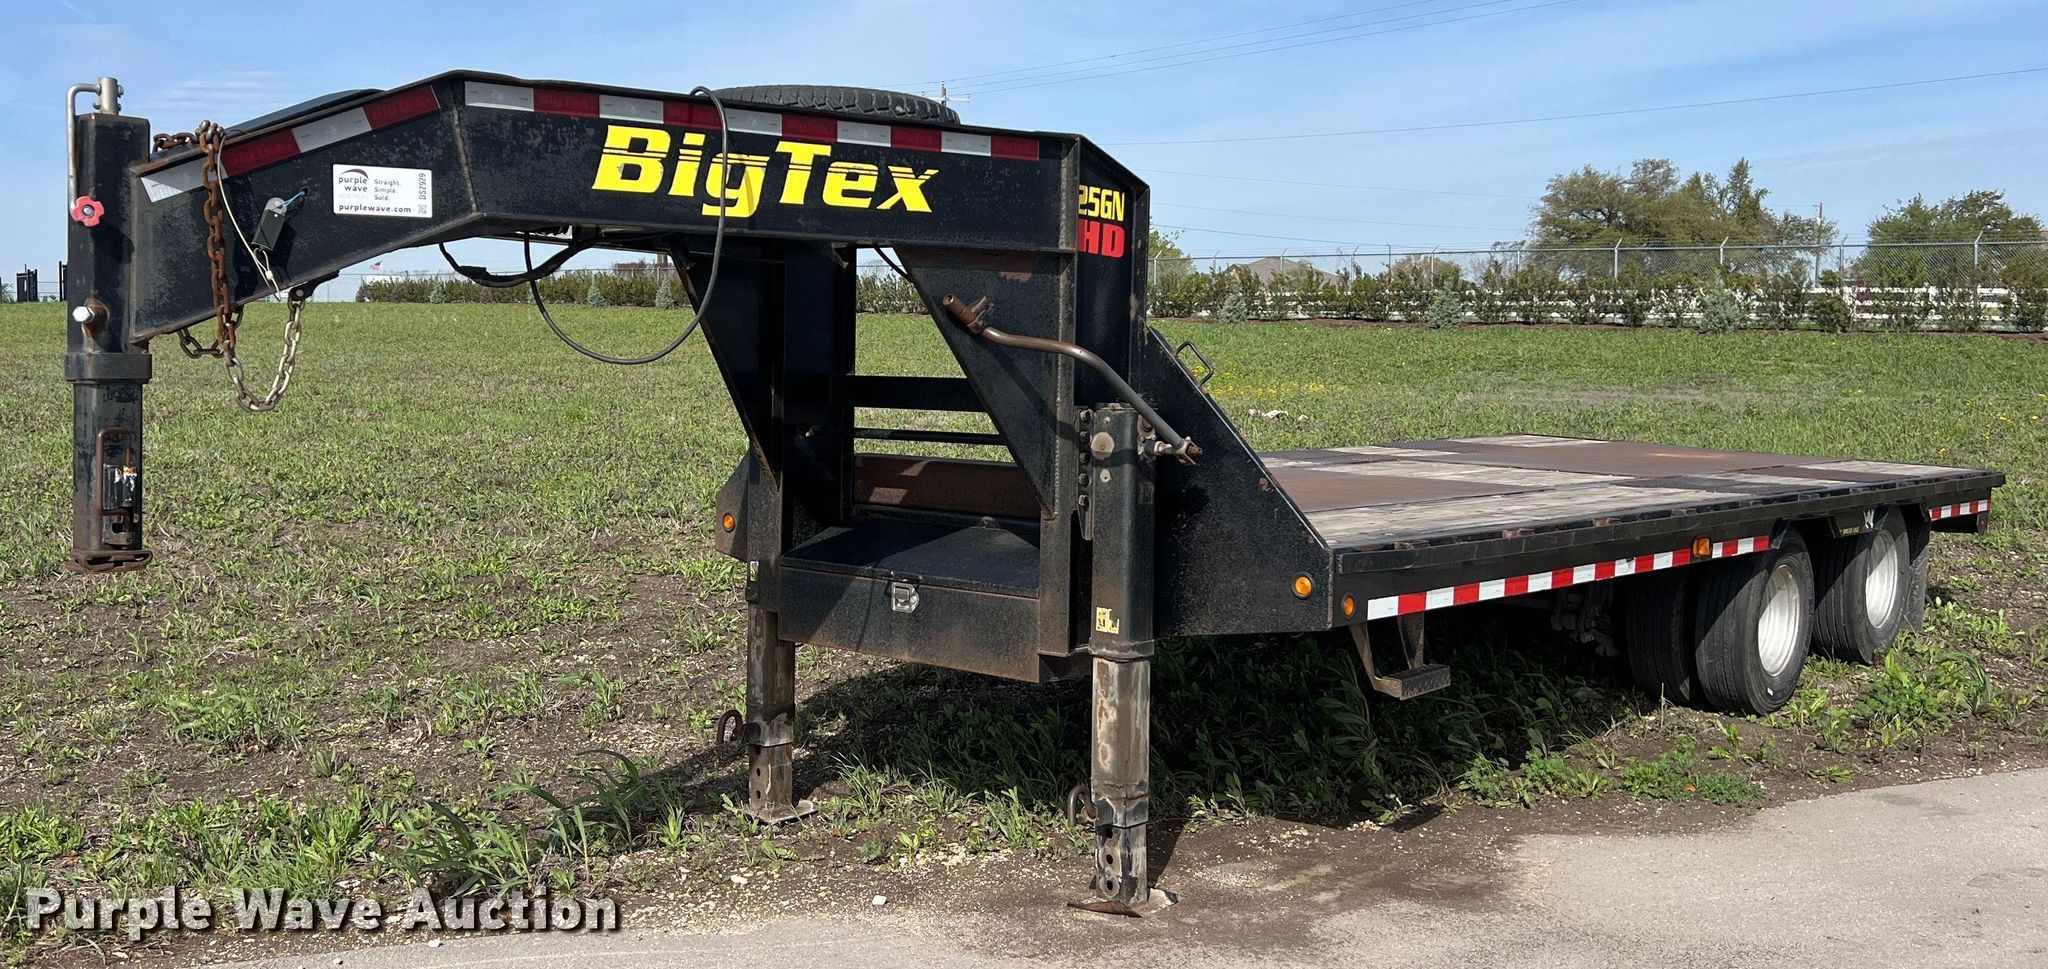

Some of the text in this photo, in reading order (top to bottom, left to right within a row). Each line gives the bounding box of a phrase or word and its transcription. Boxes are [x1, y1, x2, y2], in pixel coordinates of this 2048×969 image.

[338, 176, 368, 184] purple
[591, 124, 940, 218] BigTex
[418, 172, 427, 200] DS2929
[338, 204, 412, 213] purplewave.com
[1077, 219, 1126, 258] HD
